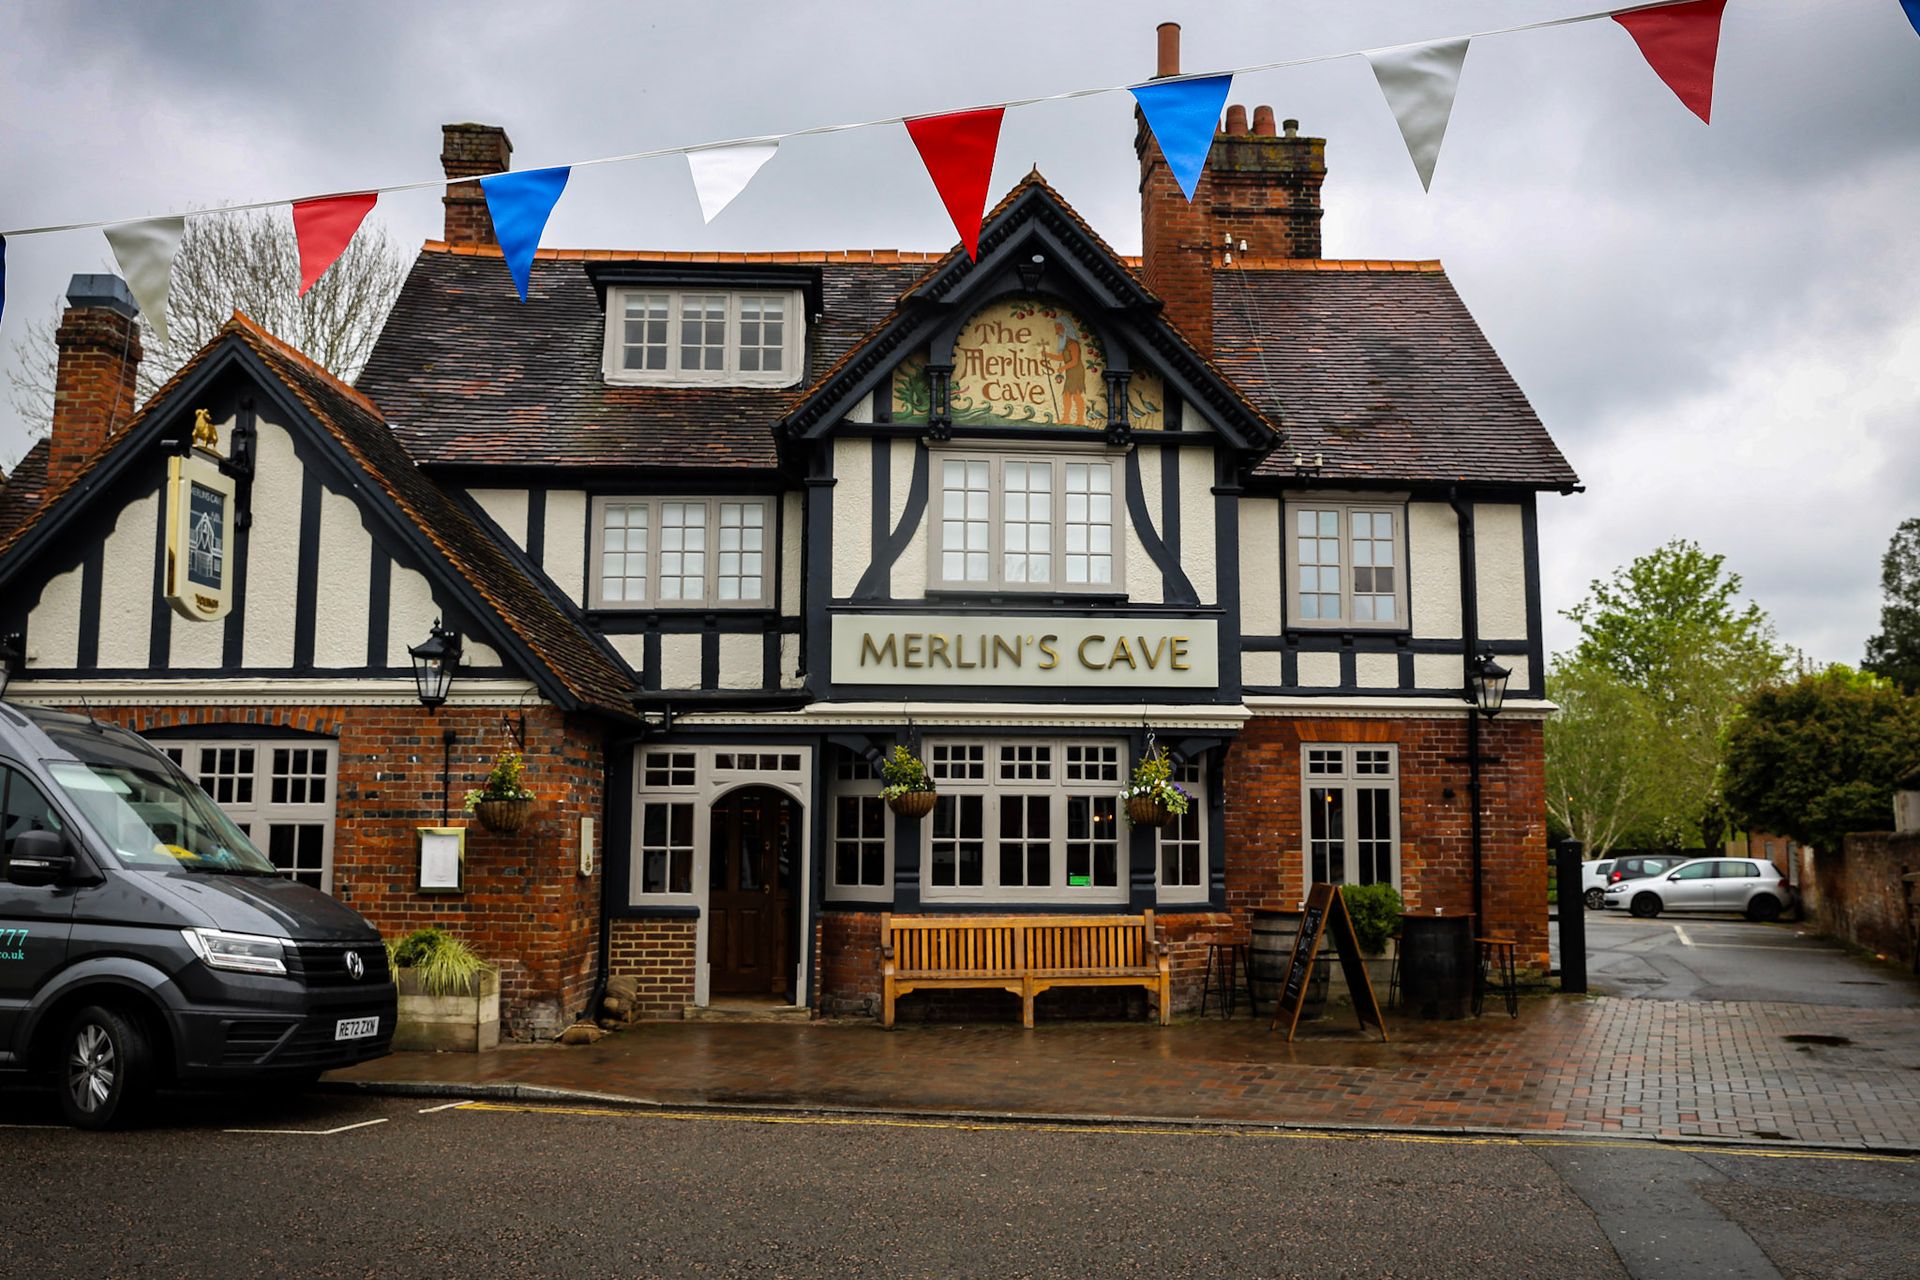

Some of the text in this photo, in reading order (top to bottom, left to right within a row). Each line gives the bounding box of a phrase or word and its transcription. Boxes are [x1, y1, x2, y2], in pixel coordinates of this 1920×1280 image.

[974, 320, 1032, 345] The
[958, 348, 1055, 381] Merlins
[860, 632, 1191, 671] MERLIN'S CAVE
[339, 1020, 360, 1037] RE72
